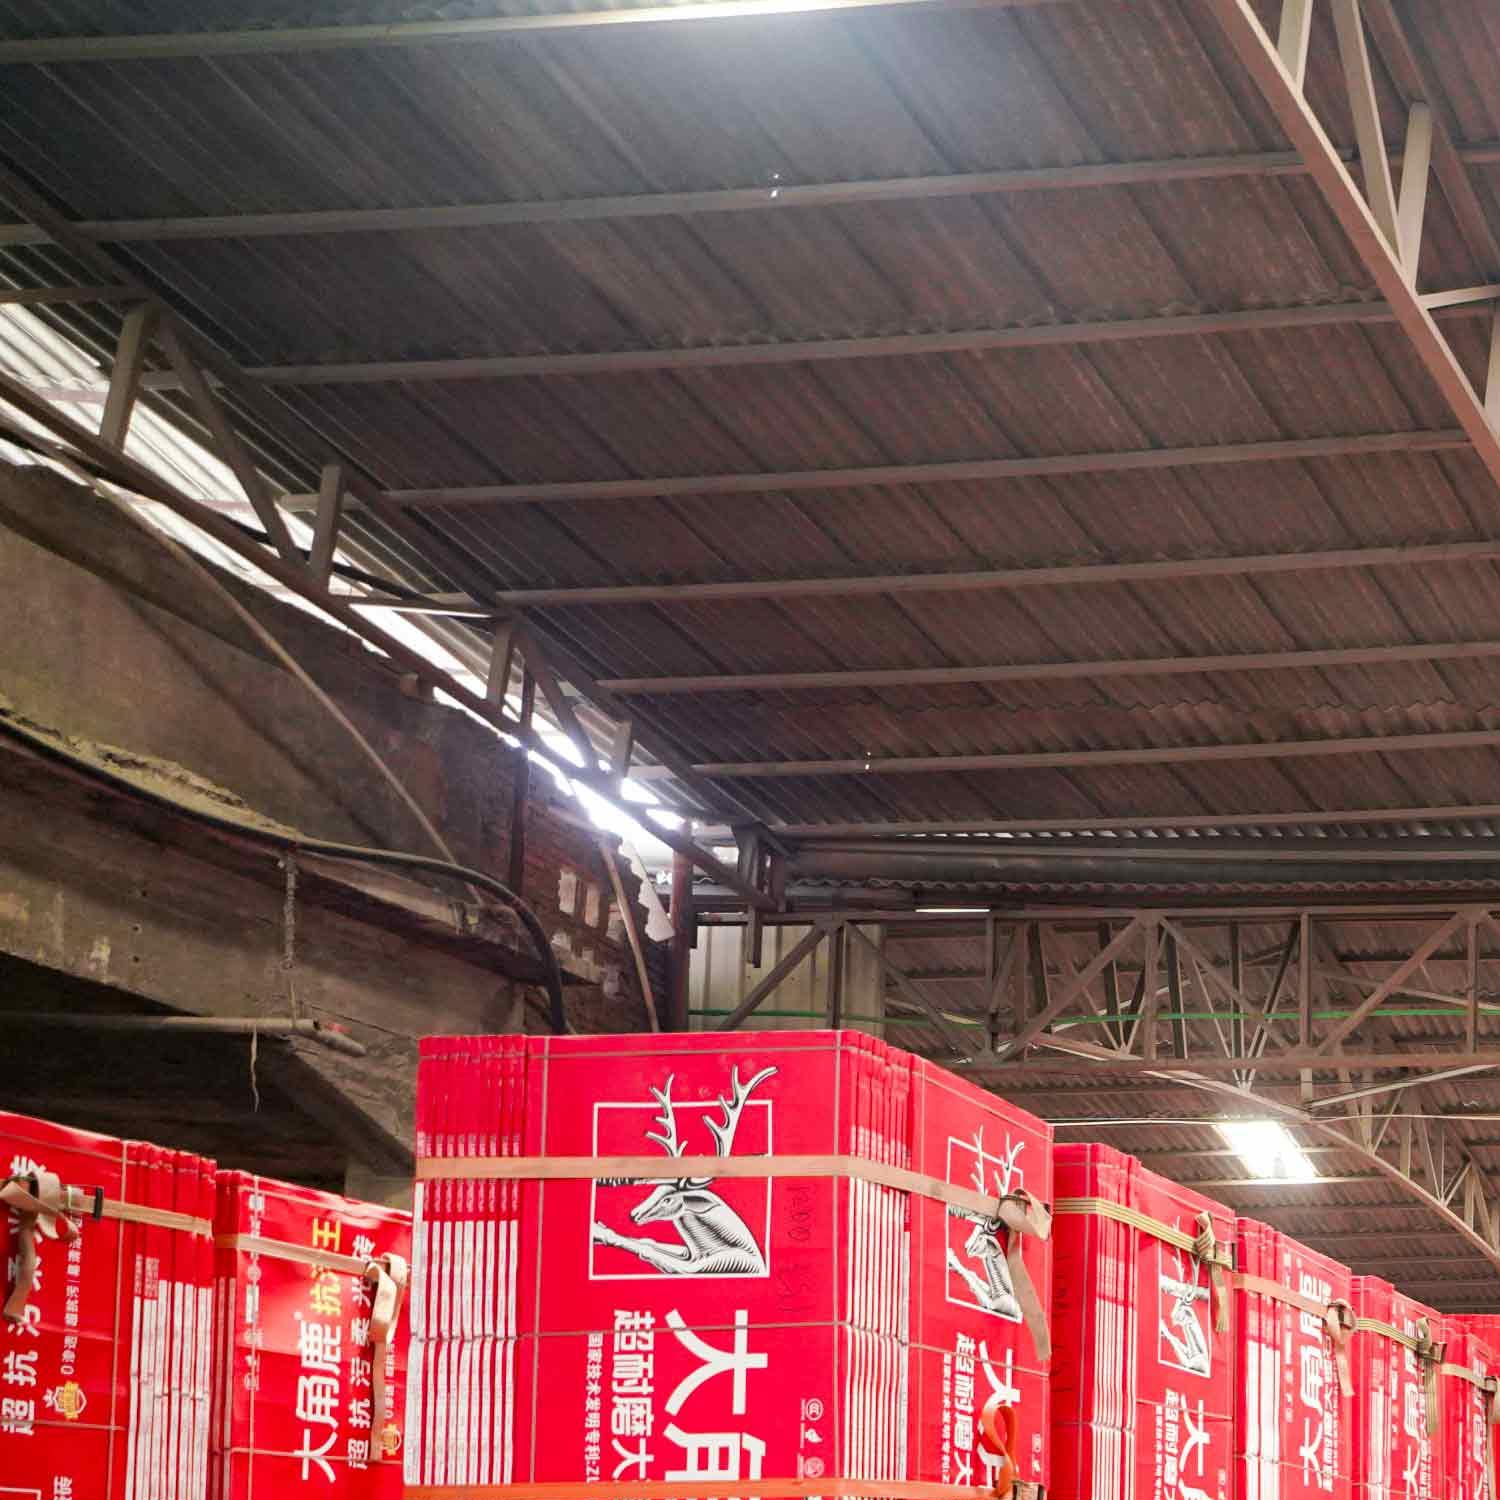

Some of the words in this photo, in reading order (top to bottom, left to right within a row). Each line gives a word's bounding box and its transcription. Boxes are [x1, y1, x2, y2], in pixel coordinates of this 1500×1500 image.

[294, 1320, 341, 1483] 大角鹿
[1300, 1275, 1323, 1488] 大角鹿
